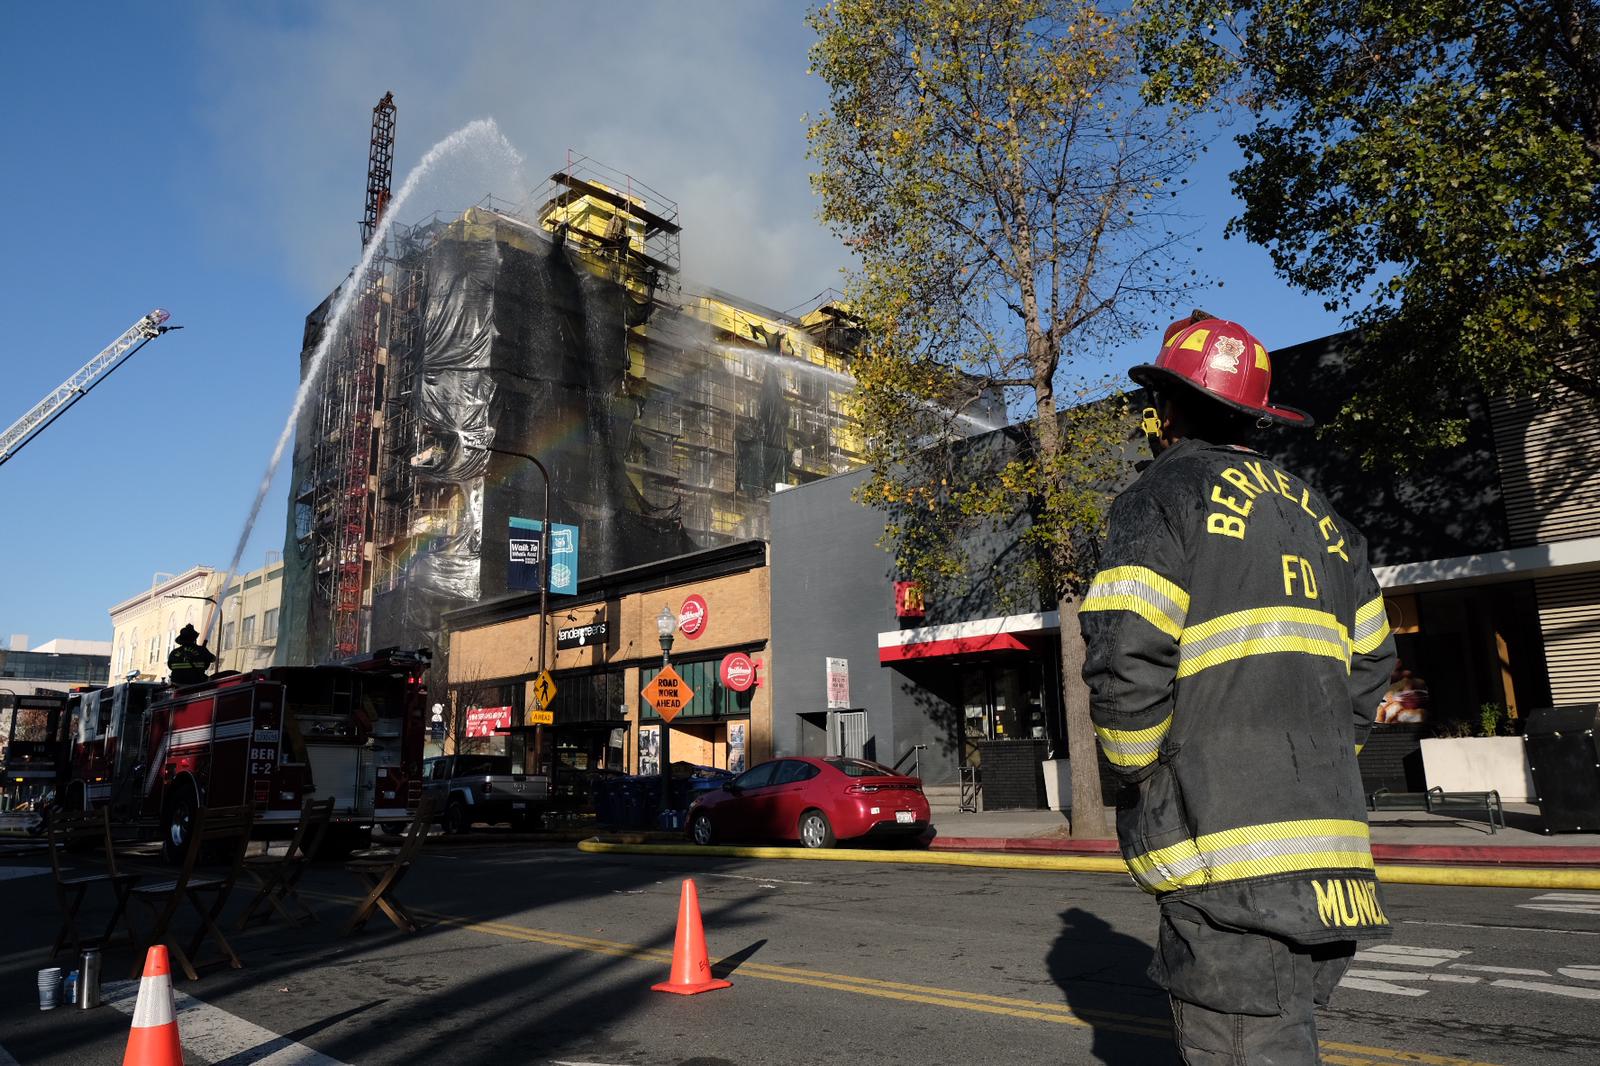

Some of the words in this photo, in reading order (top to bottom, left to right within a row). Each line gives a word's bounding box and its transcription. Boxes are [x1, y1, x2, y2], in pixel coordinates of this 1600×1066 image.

[1206, 461, 1349, 563] BERKELEY
[530, 544, 537, 552] To
[1281, 554, 1318, 600] FD
[658, 679, 678, 687] ROAD
[658, 689, 678, 697] WORK
[656, 700, 680, 708] AHEAD
[533, 713, 551, 721] AHEAD
[250, 748, 275, 760] BER
[251, 763, 272, 774] E-2
